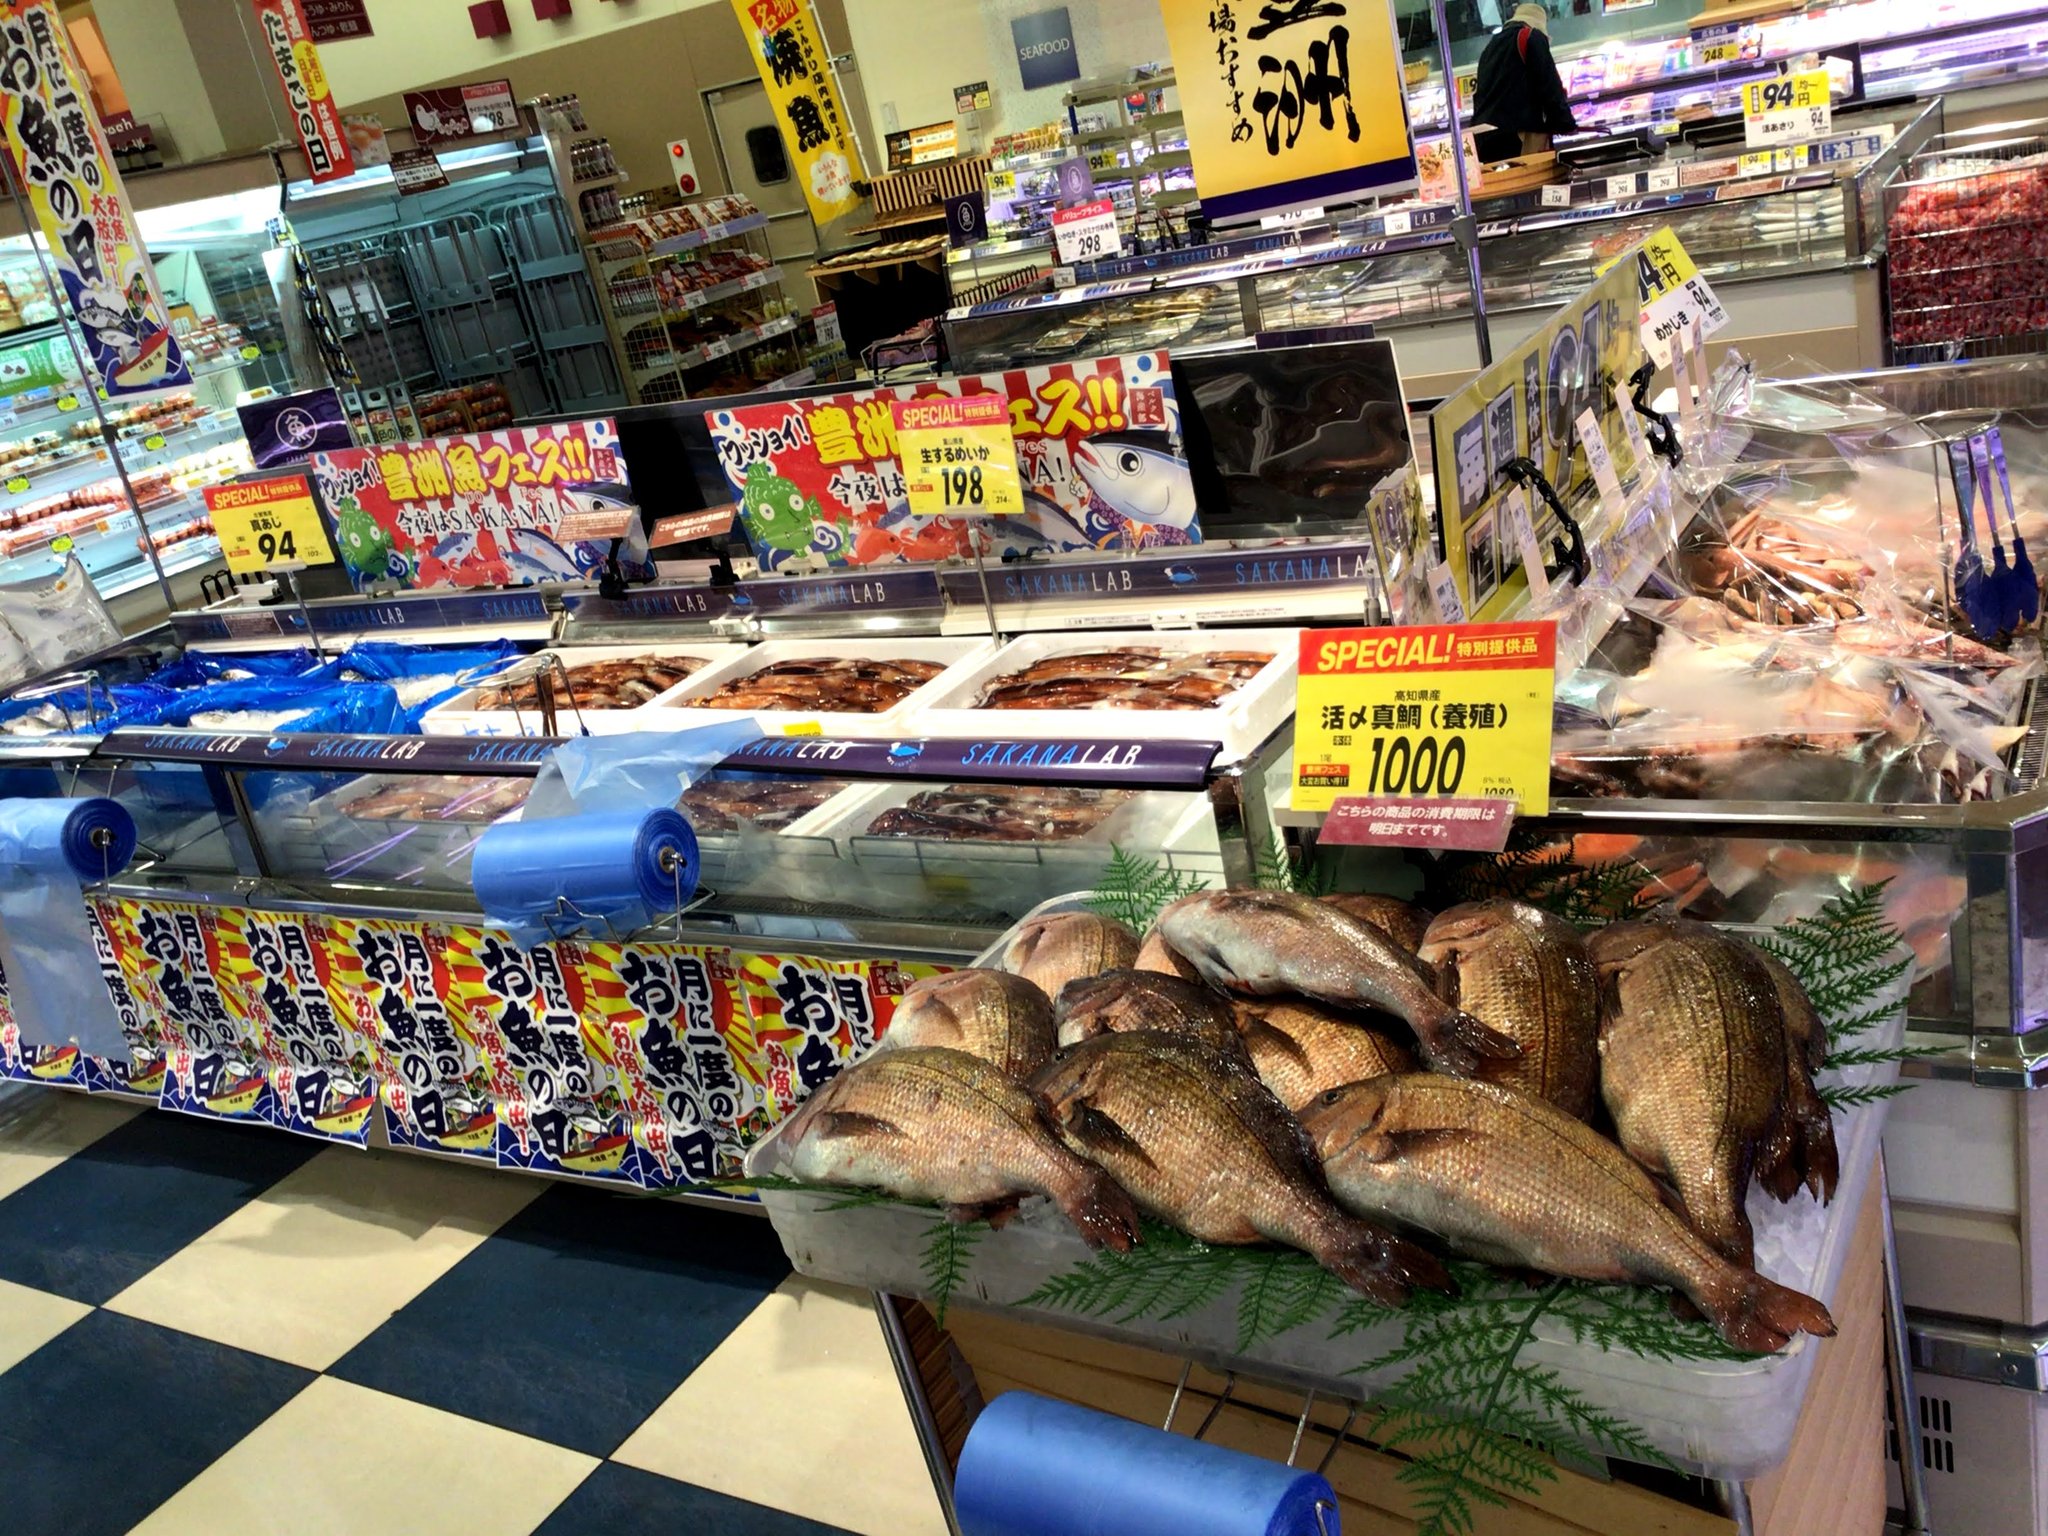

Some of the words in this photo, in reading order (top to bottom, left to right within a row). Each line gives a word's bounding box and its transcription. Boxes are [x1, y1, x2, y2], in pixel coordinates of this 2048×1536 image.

[1019, 37, 1070, 61] SEAFOOD
[1703, 47, 1724, 64] 248
[1208, 0, 1253, 143] 場おすすめ
[26, 10, 100, 187] 月に一度の
[264, 12, 331, 173] たまごの日
[1763, 81, 1795, 110] 94
[1798, 92, 1811, 106] 円
[1762, 121, 1795, 134] 活あさり
[1811, 109, 1824, 127] 94
[1062, 204, 1105, 222] バリュープライス
[1079, 233, 1102, 257] 298
[1692, 286, 1713, 312] 94
[1653, 310, 1690, 342] めかじき
[902, 403, 964, 429] SPECIAL!
[721, 412, 810, 468] ワッショイ!
[921, 446, 991, 464] 生するめいか
[321, 457, 383, 500] ワッショイ!
[377, 436, 592, 502] 豊洲魚フェス!!
[214, 484, 270, 510] SPECIAL!
[941, 465, 984, 506] 198
[249, 516, 282, 533] 真あじ
[257, 529, 298, 563] 94
[1006, 569, 1133, 598] SAKANALAB
[1236, 554, 1365, 585] SAKANALA
[778, 582, 886, 607] SAKANALAB
[1316, 633, 1456, 673] SPECIAL!
[1456, 637, 1539, 658] 特別提供品
[1394, 689, 1442, 702] 高知県産
[145, 734, 248, 753] SAKANALAB
[310, 738, 426, 760] SAKANALAB
[961, 742, 1143, 768] SAKANALAB
[1368, 735, 1466, 798] 1000
[1336, 805, 1497, 821] こちらの商品の消費期限は
[1366, 821, 1449, 838] 明日までです。
[175, 912, 236, 1044] 月に一度の
[277, 922, 346, 1062] 月に一度の
[136, 907, 225, 1101] お魚の日
[245, 917, 327, 1121] お魚の日
[400, 931, 461, 1077] 月に一度の
[354, 928, 448, 1140] お魚の日
[530, 946, 590, 1095] 月に一度の
[480, 937, 569, 1158] お魚の日
[673, 960, 735, 1117] 月に一度の
[620, 952, 716, 1179] お魚の日
